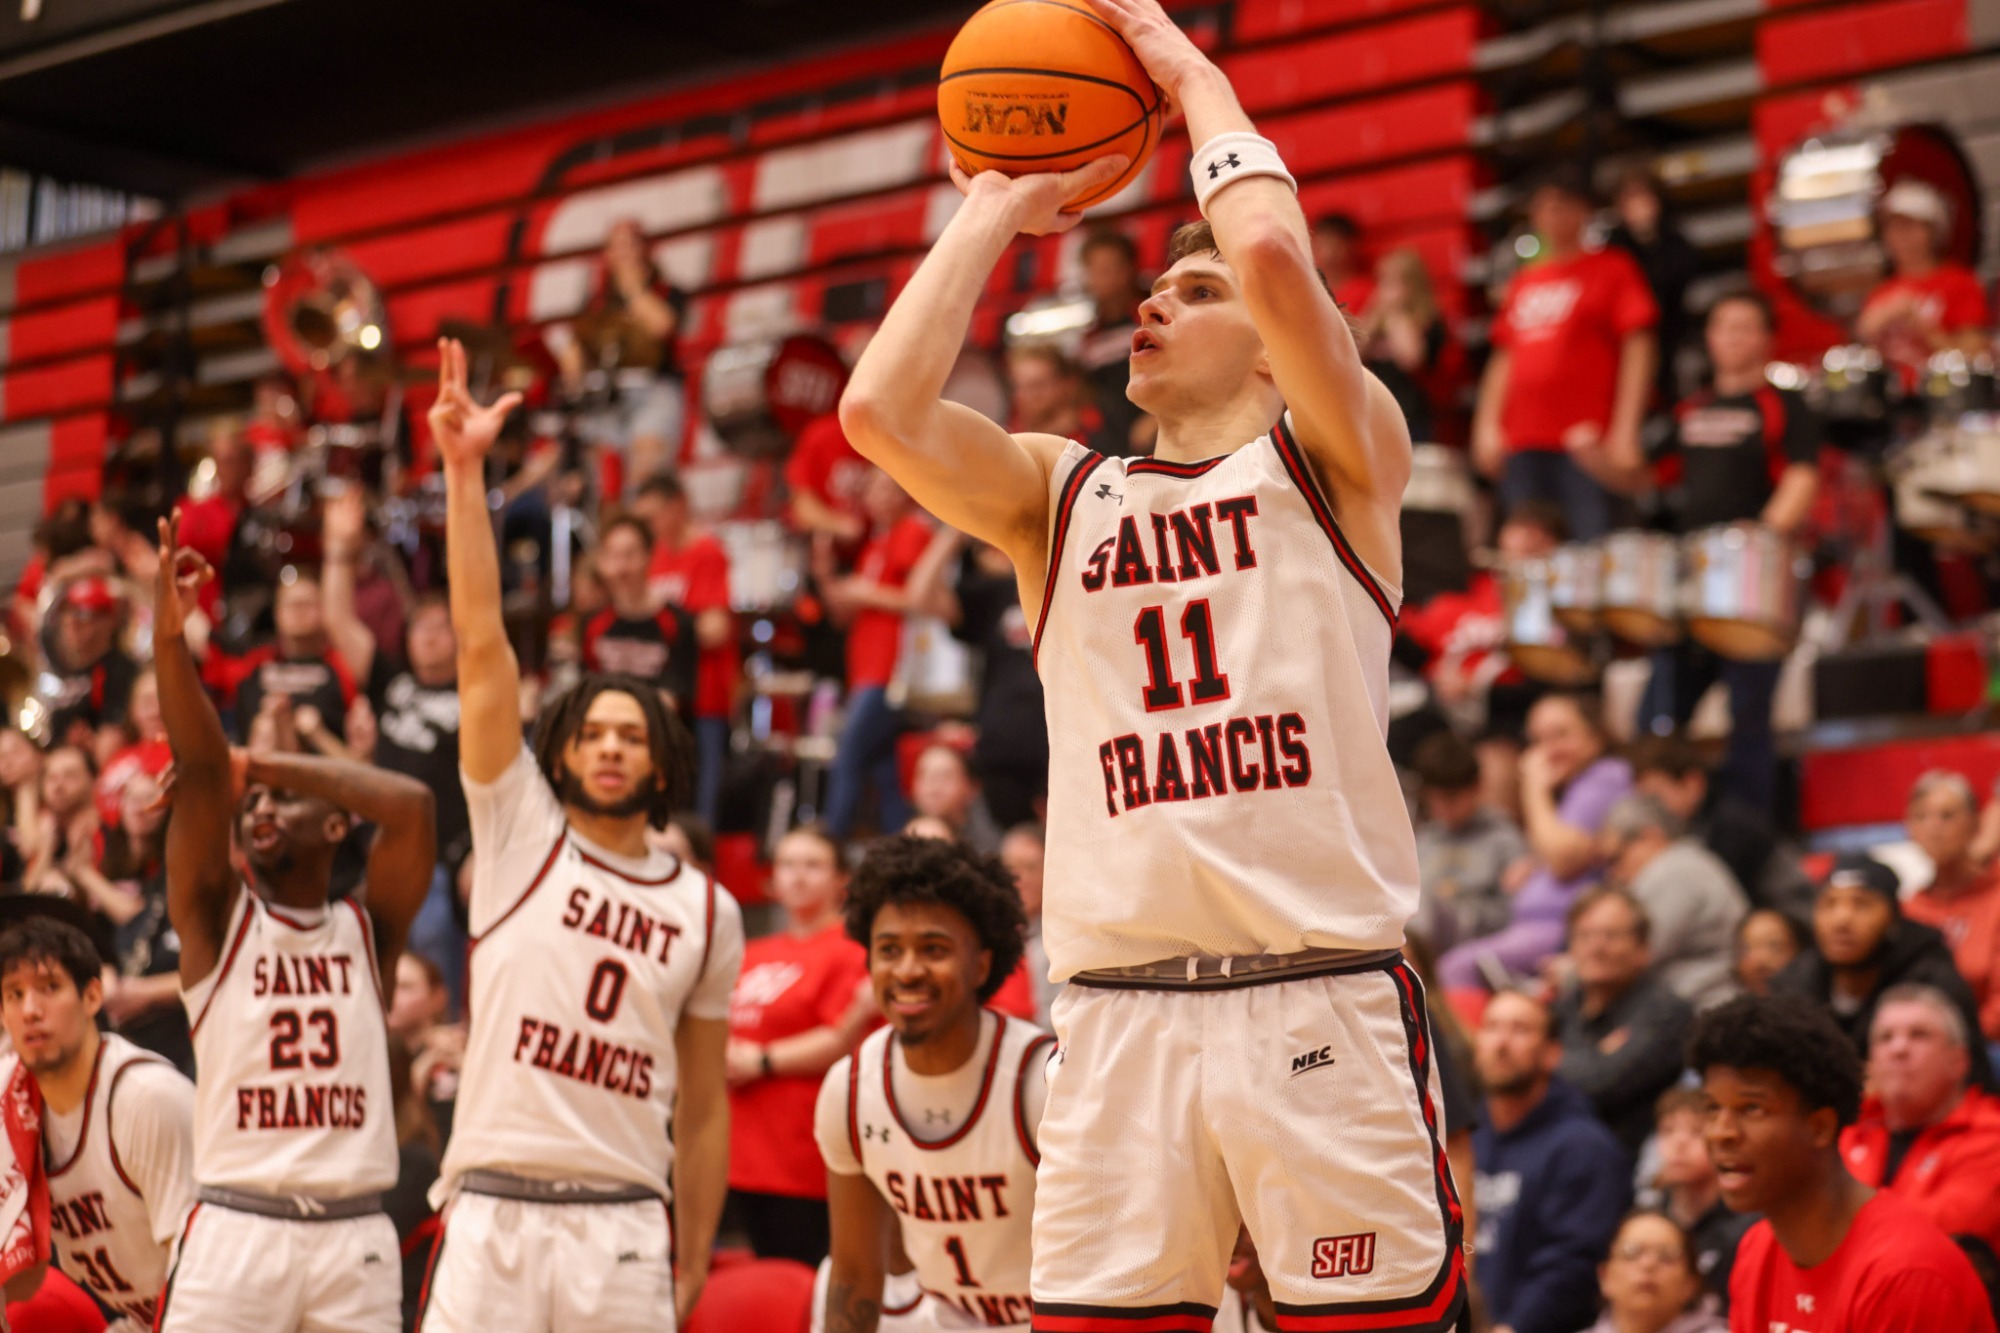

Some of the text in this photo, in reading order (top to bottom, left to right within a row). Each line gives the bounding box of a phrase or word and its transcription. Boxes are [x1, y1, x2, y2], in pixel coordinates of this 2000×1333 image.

[965, 101, 1069, 136] NCAA
[1082, 495, 1259, 593] SAINT
[1134, 598, 1231, 713] 11
[1099, 712, 1312, 818] FRANCIS
[562, 886, 682, 965] SAINT
[254, 954, 353, 997] SAINT
[585, 957, 629, 1025] 0
[269, 1008, 340, 1070] 23
[512, 1015, 655, 1100] FRANCIS
[1291, 1045, 1332, 1072] NEC
[237, 1082, 367, 1131] FRANCIS
[51, 1191, 114, 1240] INT
[886, 1171, 1010, 1222] SAINT
[71, 1245, 134, 1293] 31
[944, 1234, 982, 1288] 1
[1311, 1231, 1376, 1279] SFU
